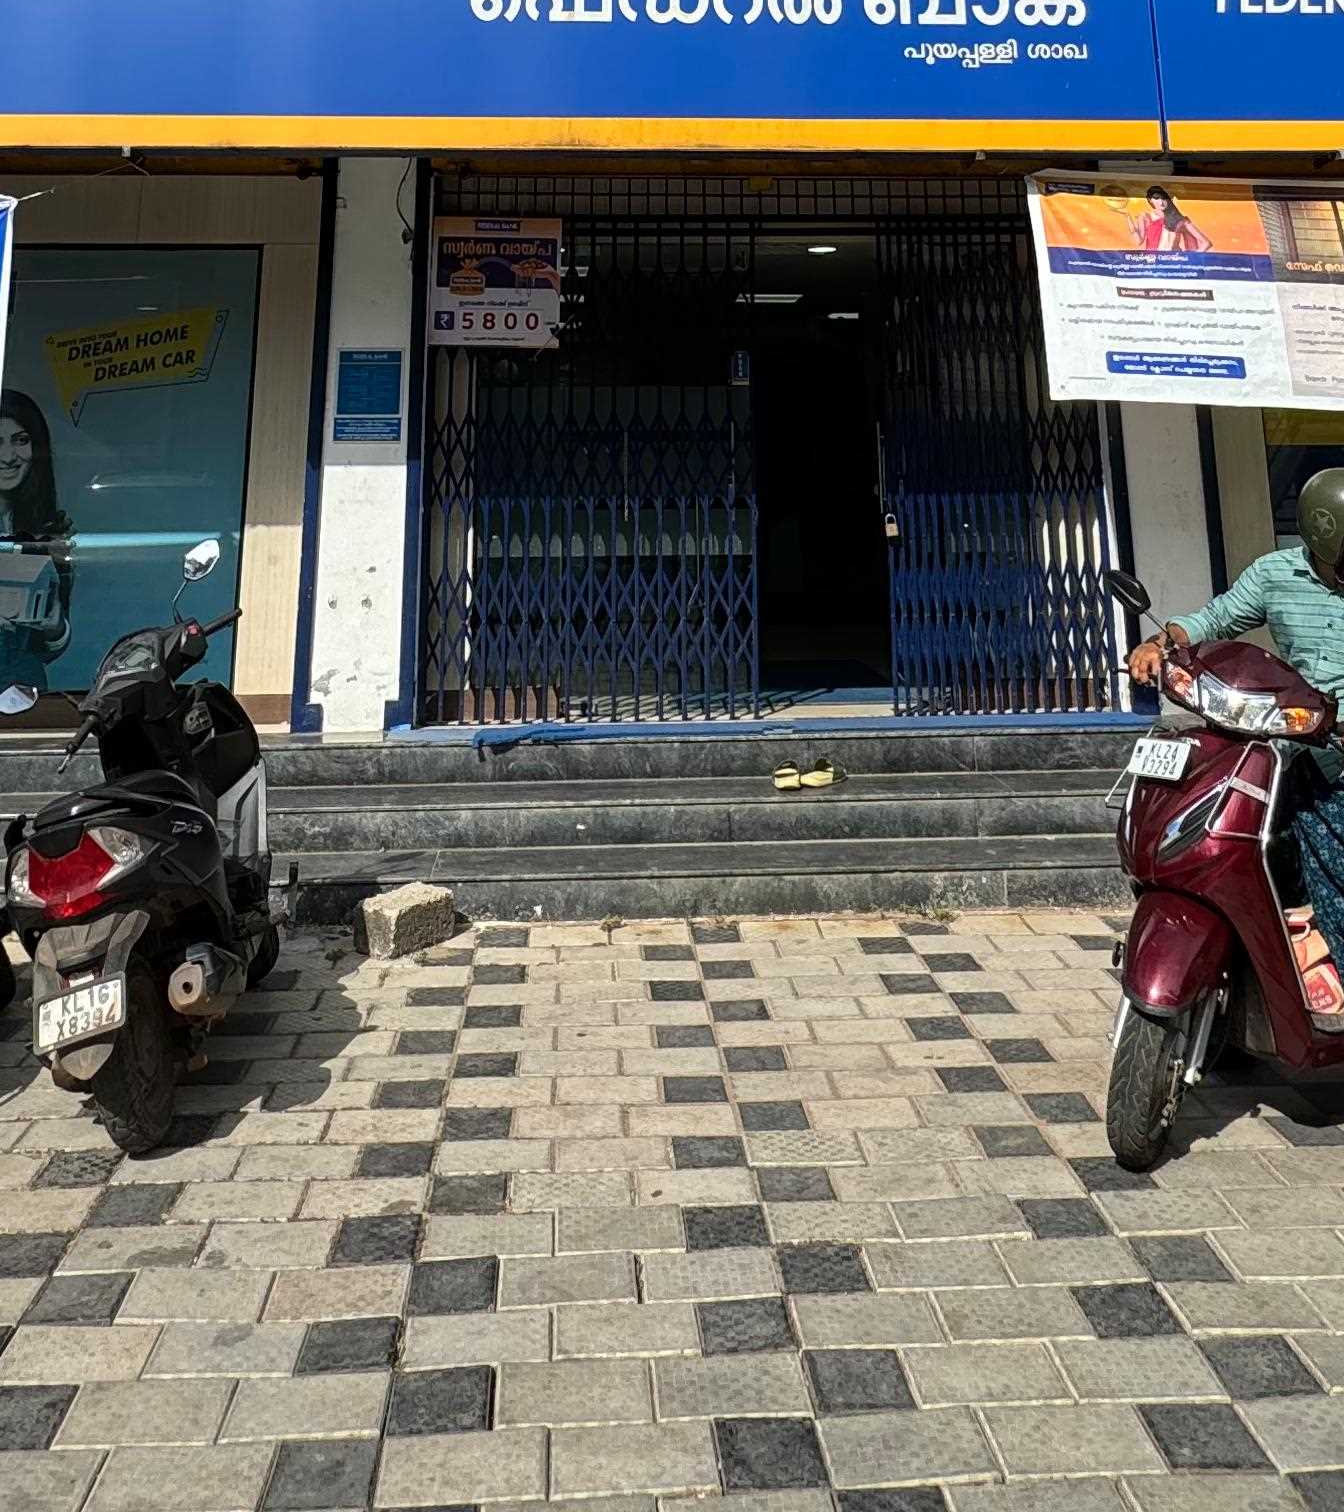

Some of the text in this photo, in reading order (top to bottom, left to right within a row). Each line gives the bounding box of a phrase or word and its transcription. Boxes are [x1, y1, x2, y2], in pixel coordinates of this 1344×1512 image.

[903, 39, 1088, 68] പൂയപ്പള്ളി ശാഖ
[68, 336, 129, 361] DREAM
[136, 325, 190, 348] HOME
[94, 358, 155, 382] DREAM
[162, 349, 196, 368] CAR
